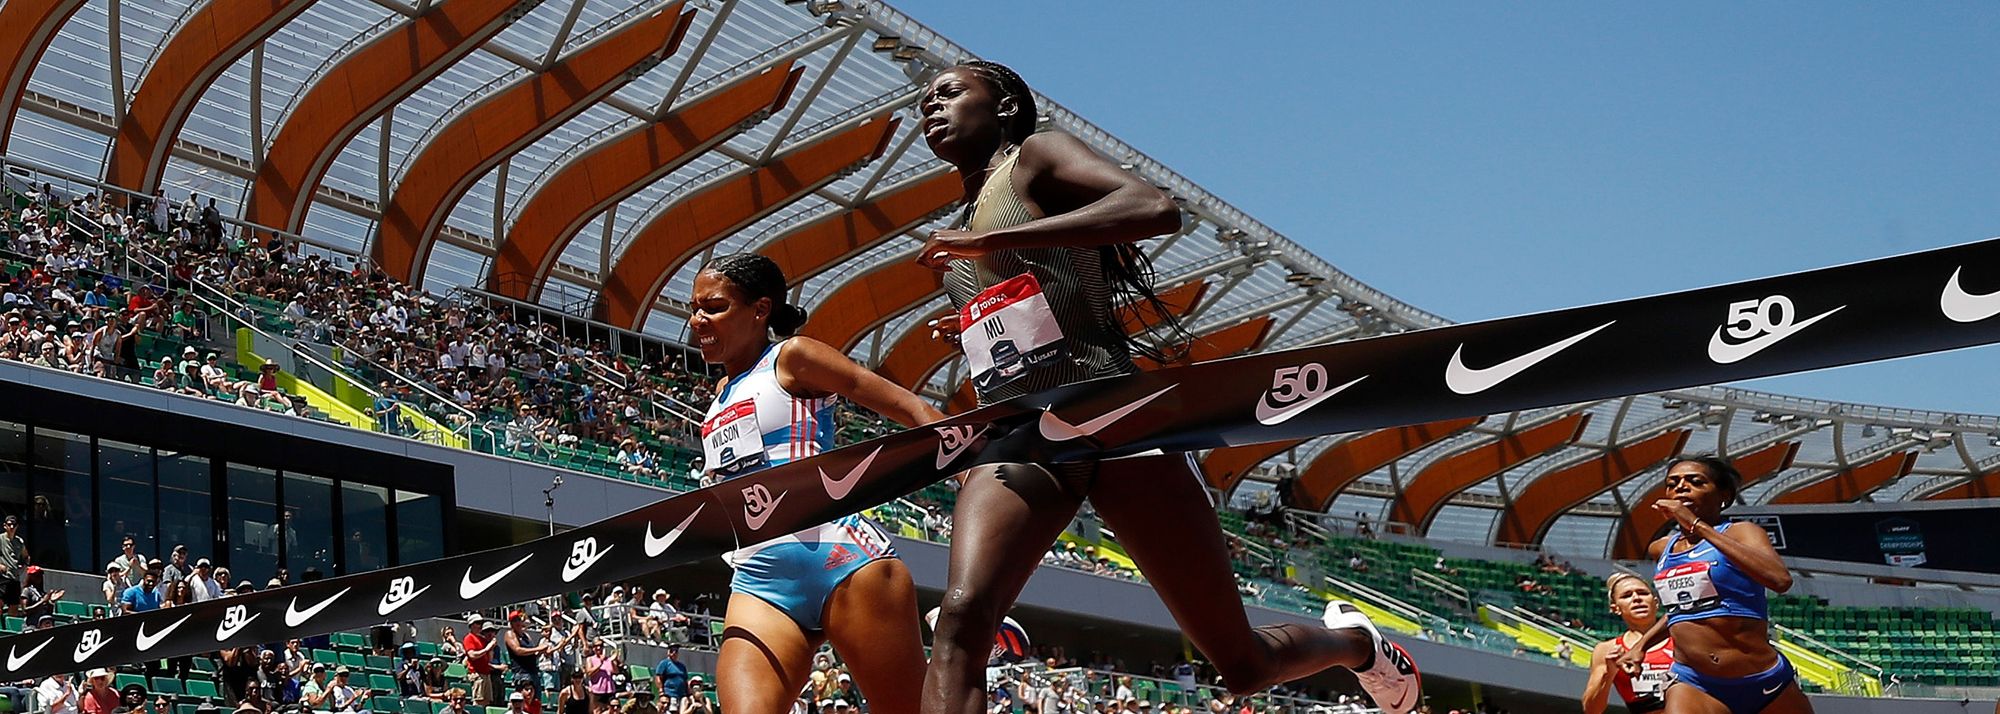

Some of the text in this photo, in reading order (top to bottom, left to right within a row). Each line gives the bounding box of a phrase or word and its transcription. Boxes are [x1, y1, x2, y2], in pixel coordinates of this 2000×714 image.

[983, 315, 1006, 340] MU
[1727, 295, 1795, 339] 50
[1271, 363, 1328, 402] 50
[711, 423, 740, 449] WILSON
[741, 484, 773, 512] 50
[571, 536, 597, 567] 50
[388, 575, 414, 602] 50
[1668, 576, 1696, 590] ROGERS
[224, 604, 247, 629] 50
[80, 628, 102, 651] 50
